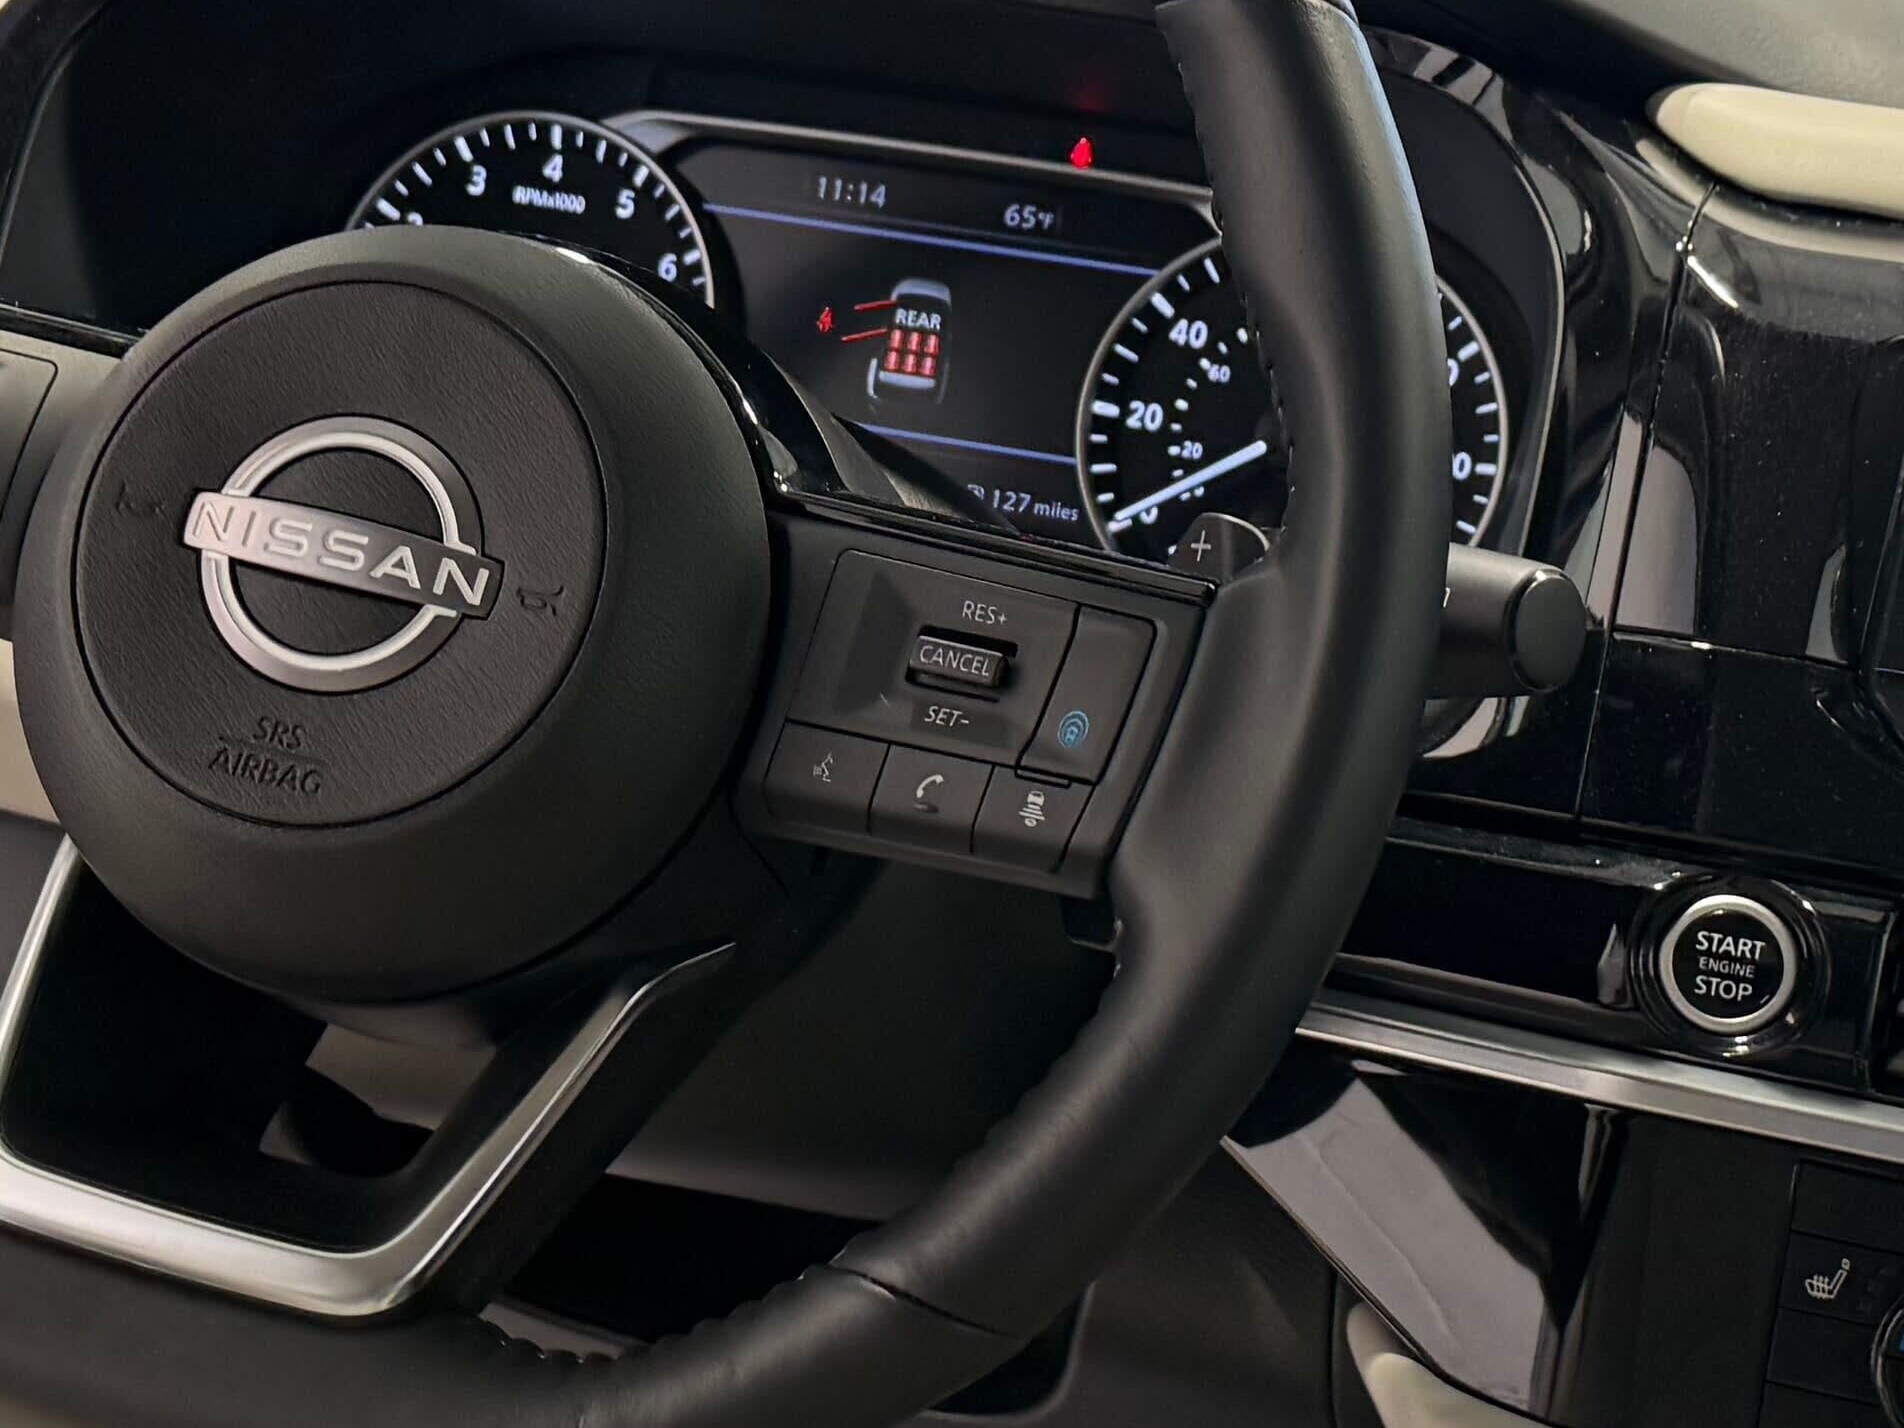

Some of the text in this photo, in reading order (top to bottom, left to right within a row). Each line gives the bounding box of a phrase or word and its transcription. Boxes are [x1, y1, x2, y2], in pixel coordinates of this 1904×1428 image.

[465, 164, 487, 196] 3
[543, 153, 564, 182] 4
[614, 188, 636, 220] 5
[817, 176, 887, 208] 11:14
[657, 253, 677, 281] 6
[896, 308, 941, 330] REAR
[1168, 318, 1208, 349] 40
[1126, 399, 1163, 431] 20
[1181, 440, 1203, 459] 20
[992, 488, 1080, 521] 127 miles
[193, 500, 492, 607] NISSAN
[919, 644, 989, 677] CANCEL
[253, 715, 302, 749] SRS
[208, 746, 321, 795] AIRBAG
[1696, 930, 1766, 960] START
[1698, 956, 1755, 978] ENGINE
[1694, 975, 1753, 1001] STOP
